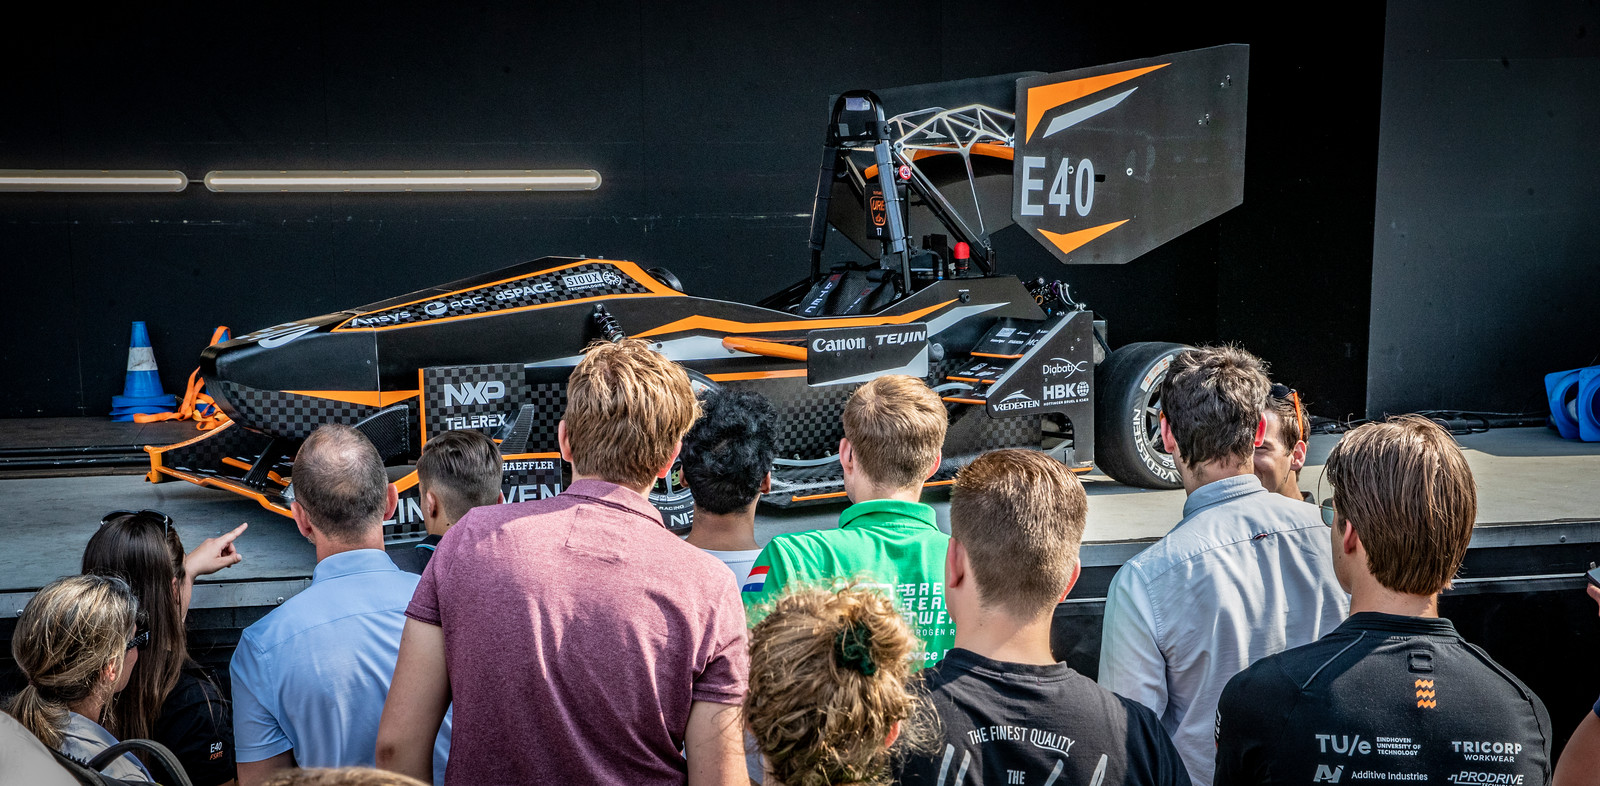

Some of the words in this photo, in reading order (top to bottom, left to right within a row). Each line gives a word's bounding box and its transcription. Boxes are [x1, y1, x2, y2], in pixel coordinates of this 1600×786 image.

[1020, 155, 1095, 217] E40
[566, 272, 600, 286] SIOUX
[351, 310, 411, 327] Ansys
[495, 281, 555, 301] dSPACE
[812, 336, 866, 353] Canon
[875, 330, 926, 346] TEIJIN
[443, 380, 506, 407] NXP
[1043, 382, 1077, 401] HBK
[992, 400, 1040, 412] VREDESTEIN
[502, 461, 554, 471] HAEFFLER
[897, 582, 943, 596] GRE
[914, 628, 946, 636] ROGEN
[967, 727, 989, 745] THE
[990, 725, 1028, 742] FINEST
[1029, 728, 1076, 757] QUALITY
[1315, 734, 1371, 756] TU/e
[1451, 741, 1522, 754] TRICORP
[1464, 754, 1515, 762] WORKWEAR
[1007, 769, 1026, 785] THE
[1351, 771, 1386, 780] Additive
[1387, 772, 1428, 781] Industries
[1459, 771, 1524, 785] PRODRIVE
